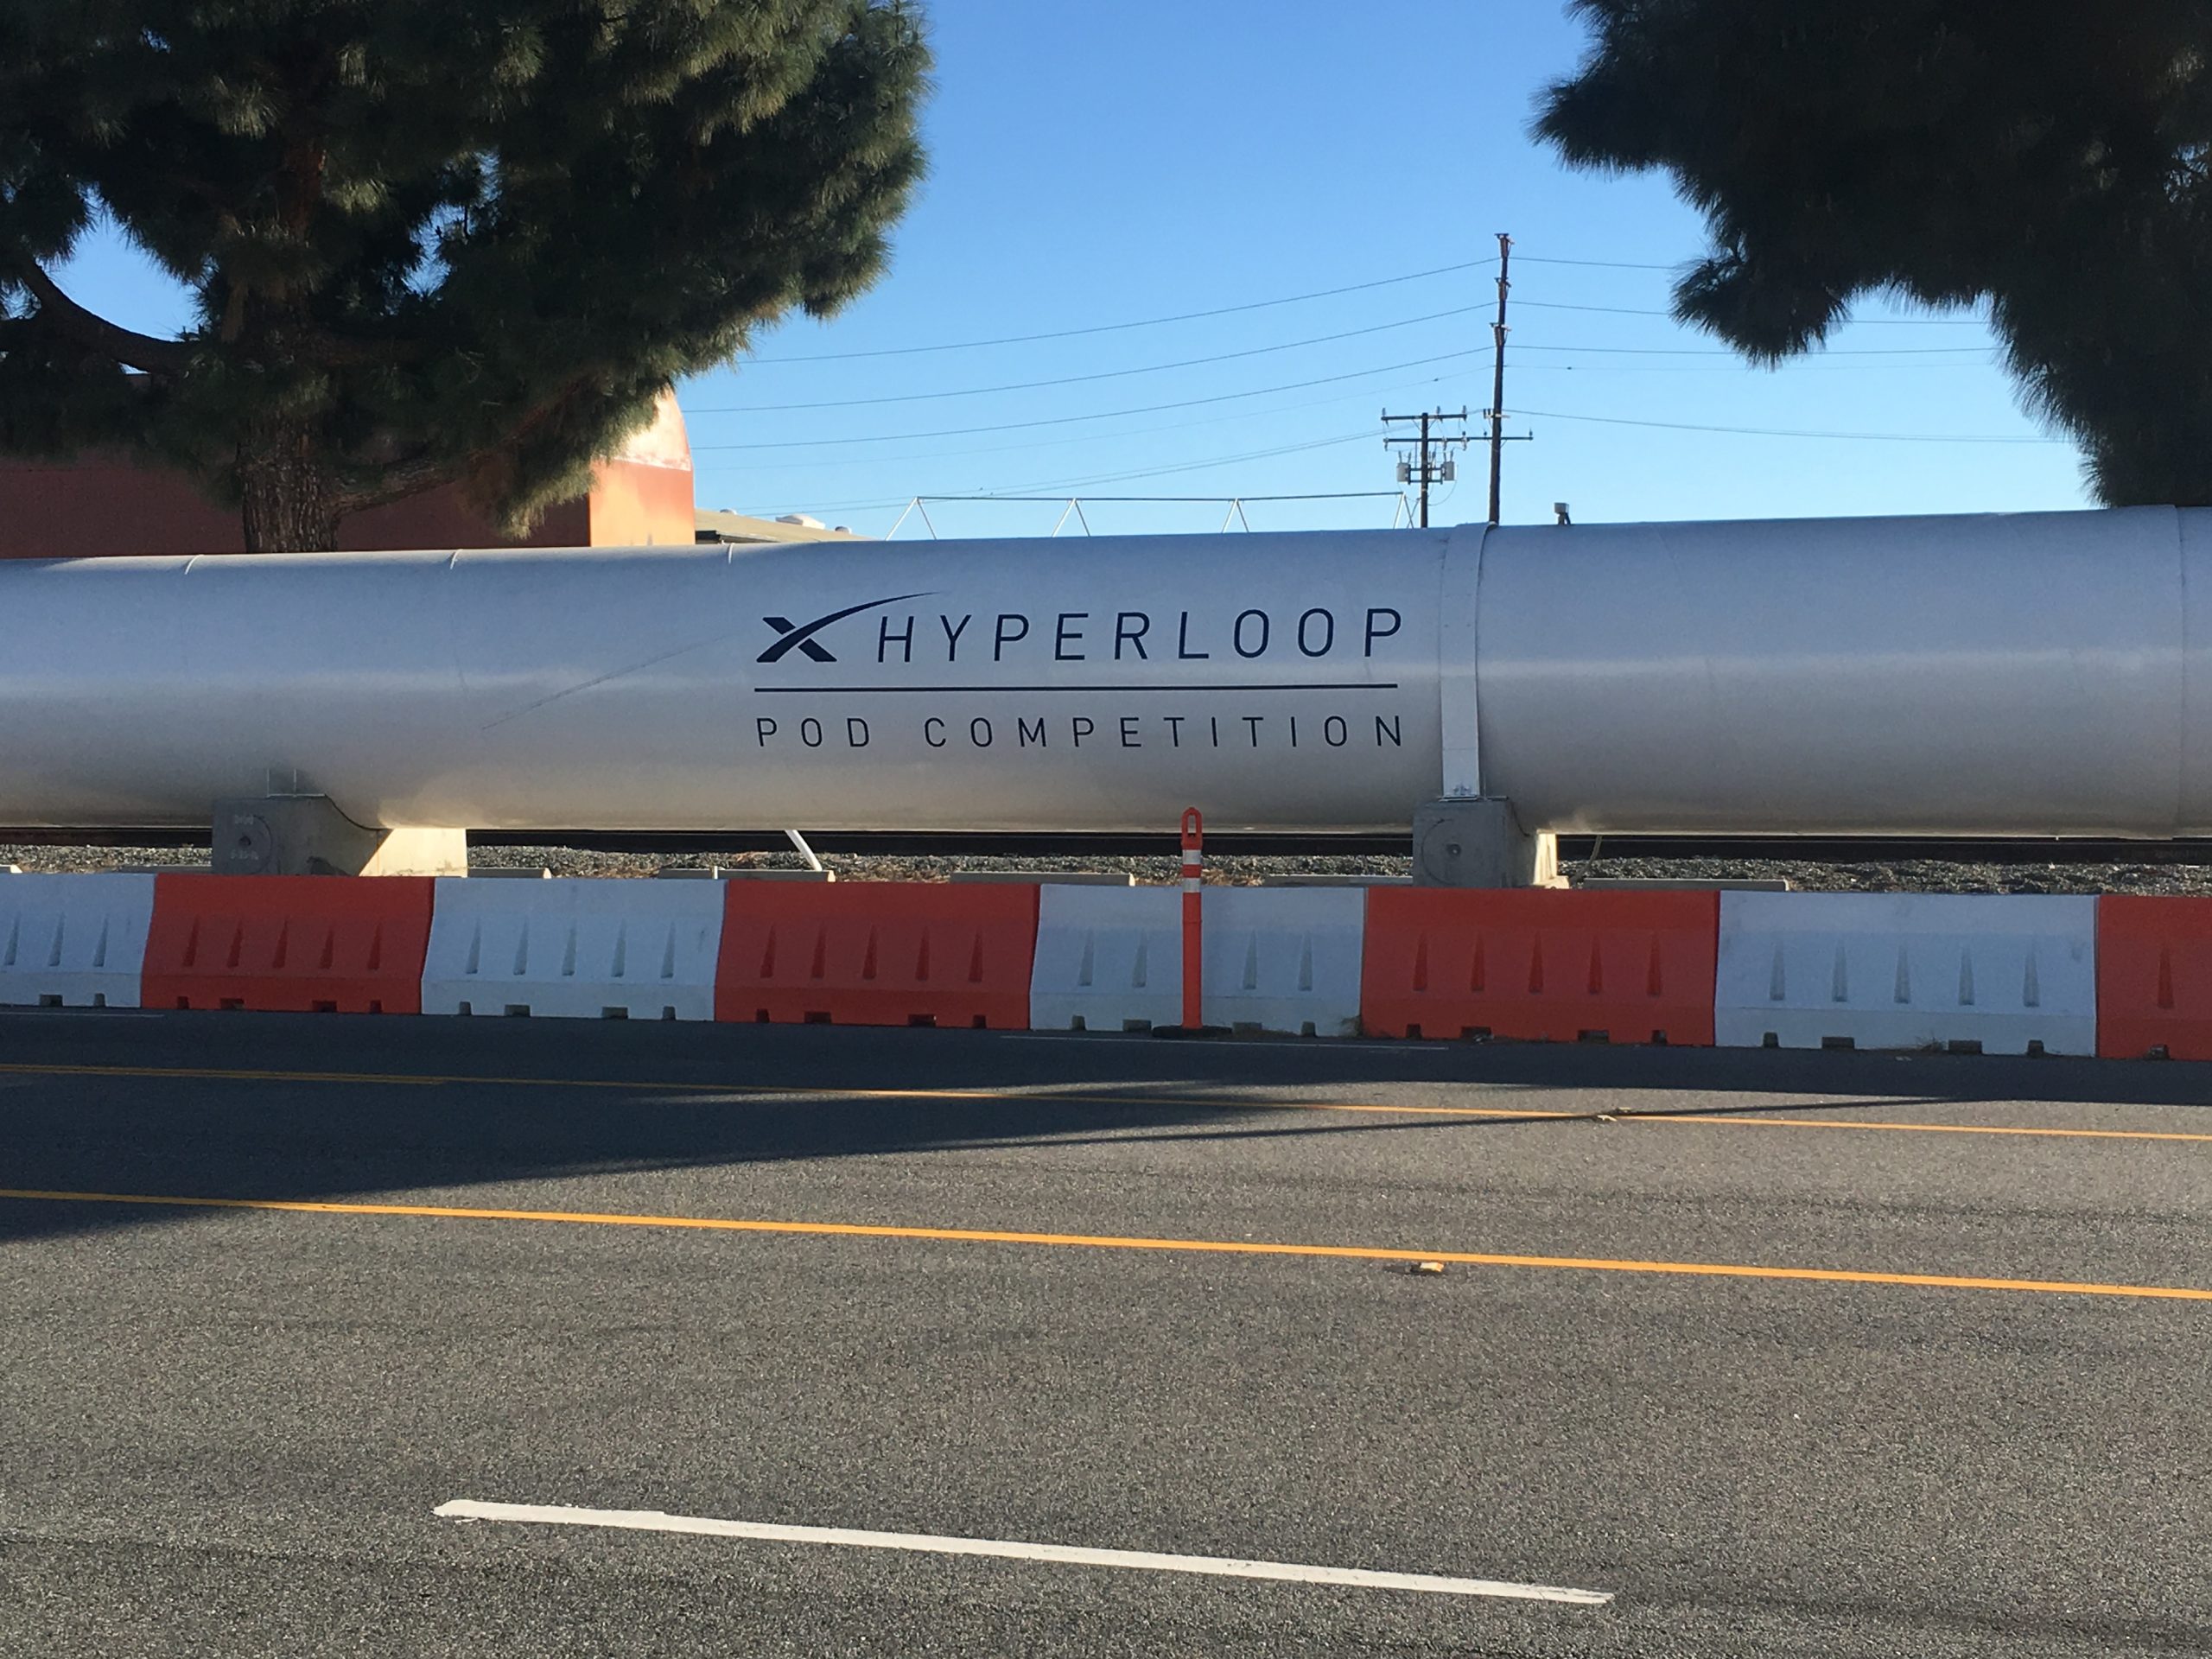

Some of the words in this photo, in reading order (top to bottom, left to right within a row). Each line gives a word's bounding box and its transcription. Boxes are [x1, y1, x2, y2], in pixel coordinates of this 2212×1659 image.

[877, 607, 1402, 664] HYPERLOOP
[756, 717, 870, 747] POD
[924, 715, 1402, 748] COMPETITION
